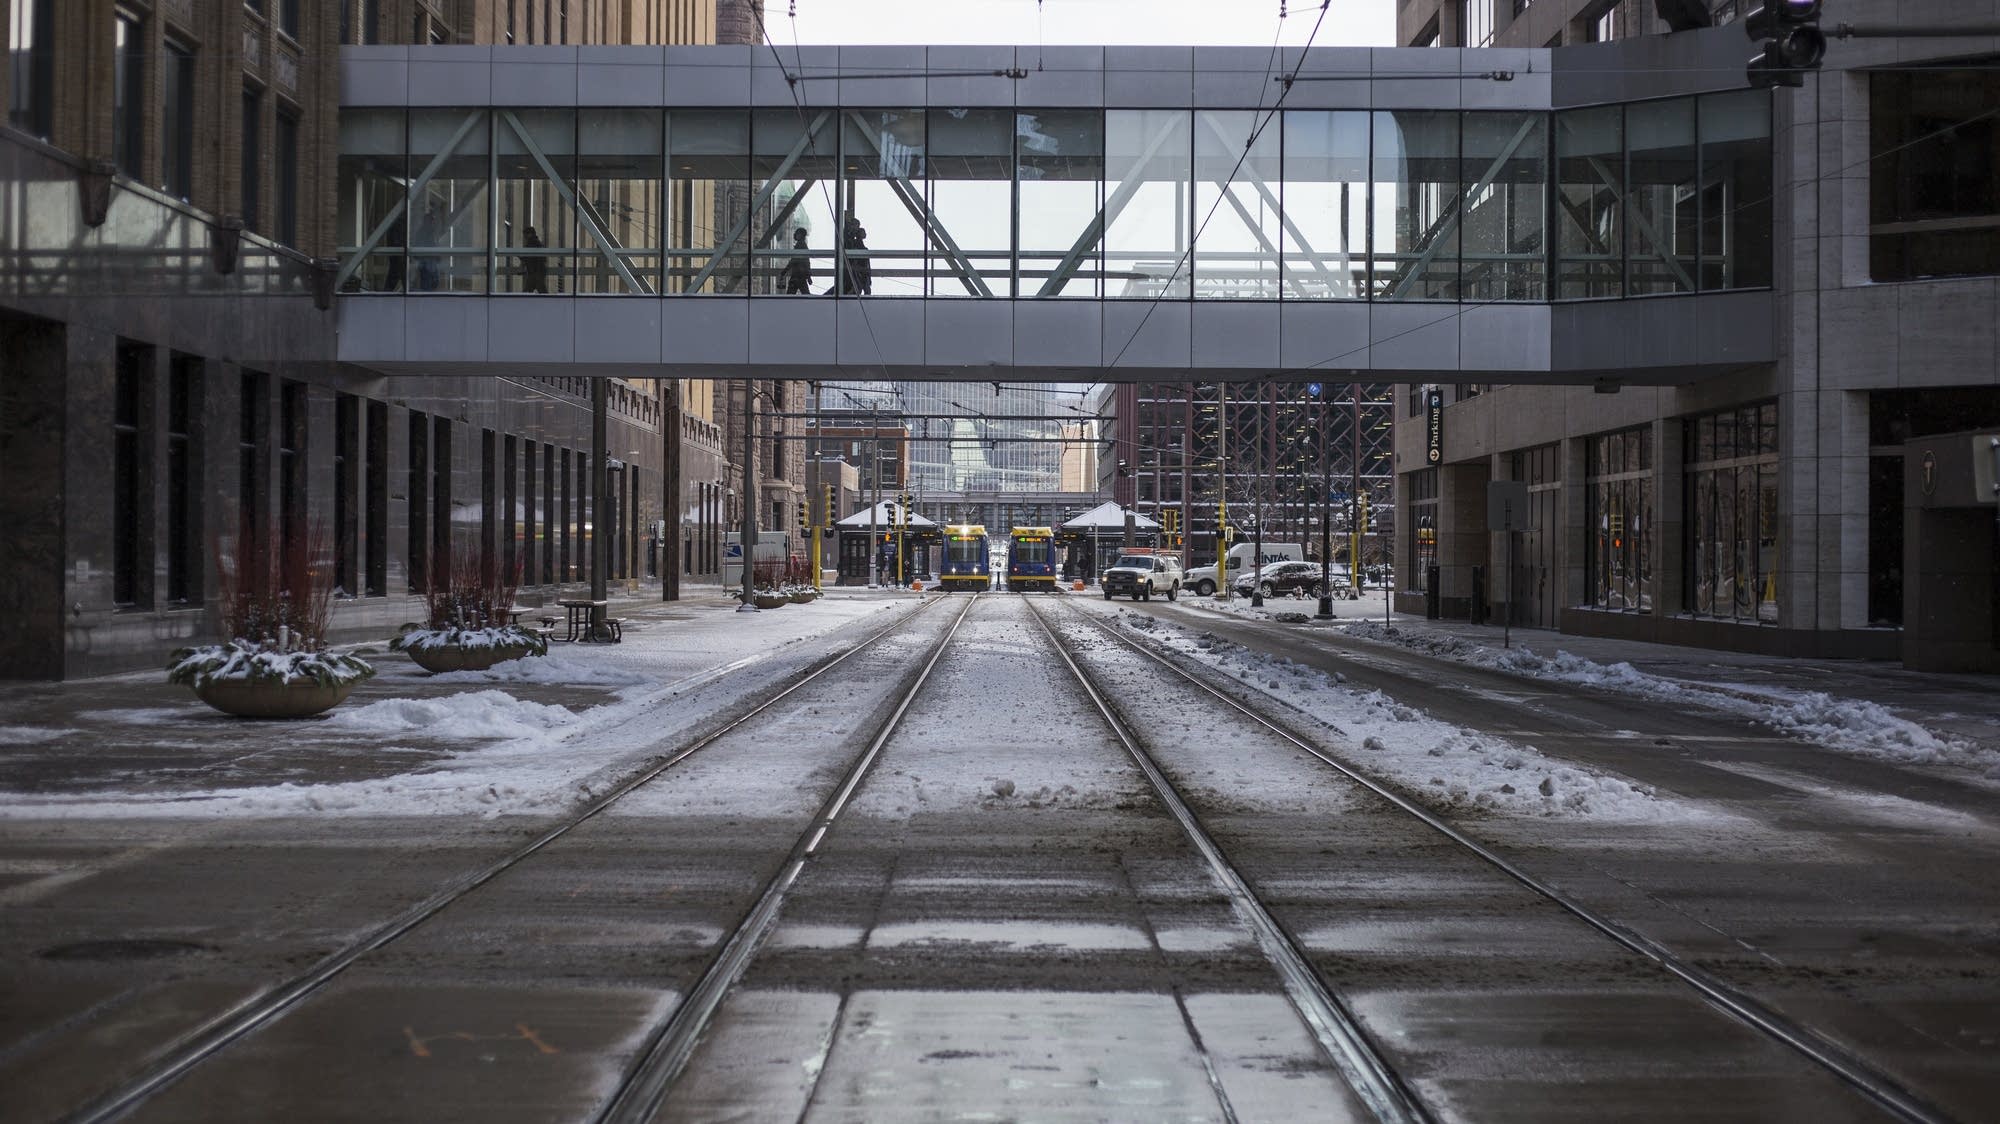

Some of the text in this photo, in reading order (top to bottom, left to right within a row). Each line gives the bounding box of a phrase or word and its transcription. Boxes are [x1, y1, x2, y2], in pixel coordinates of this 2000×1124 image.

[1431, 395, 1439, 406] P
[1431, 407, 1440, 447] Parking
[1254, 551, 1291, 564] INTAS
